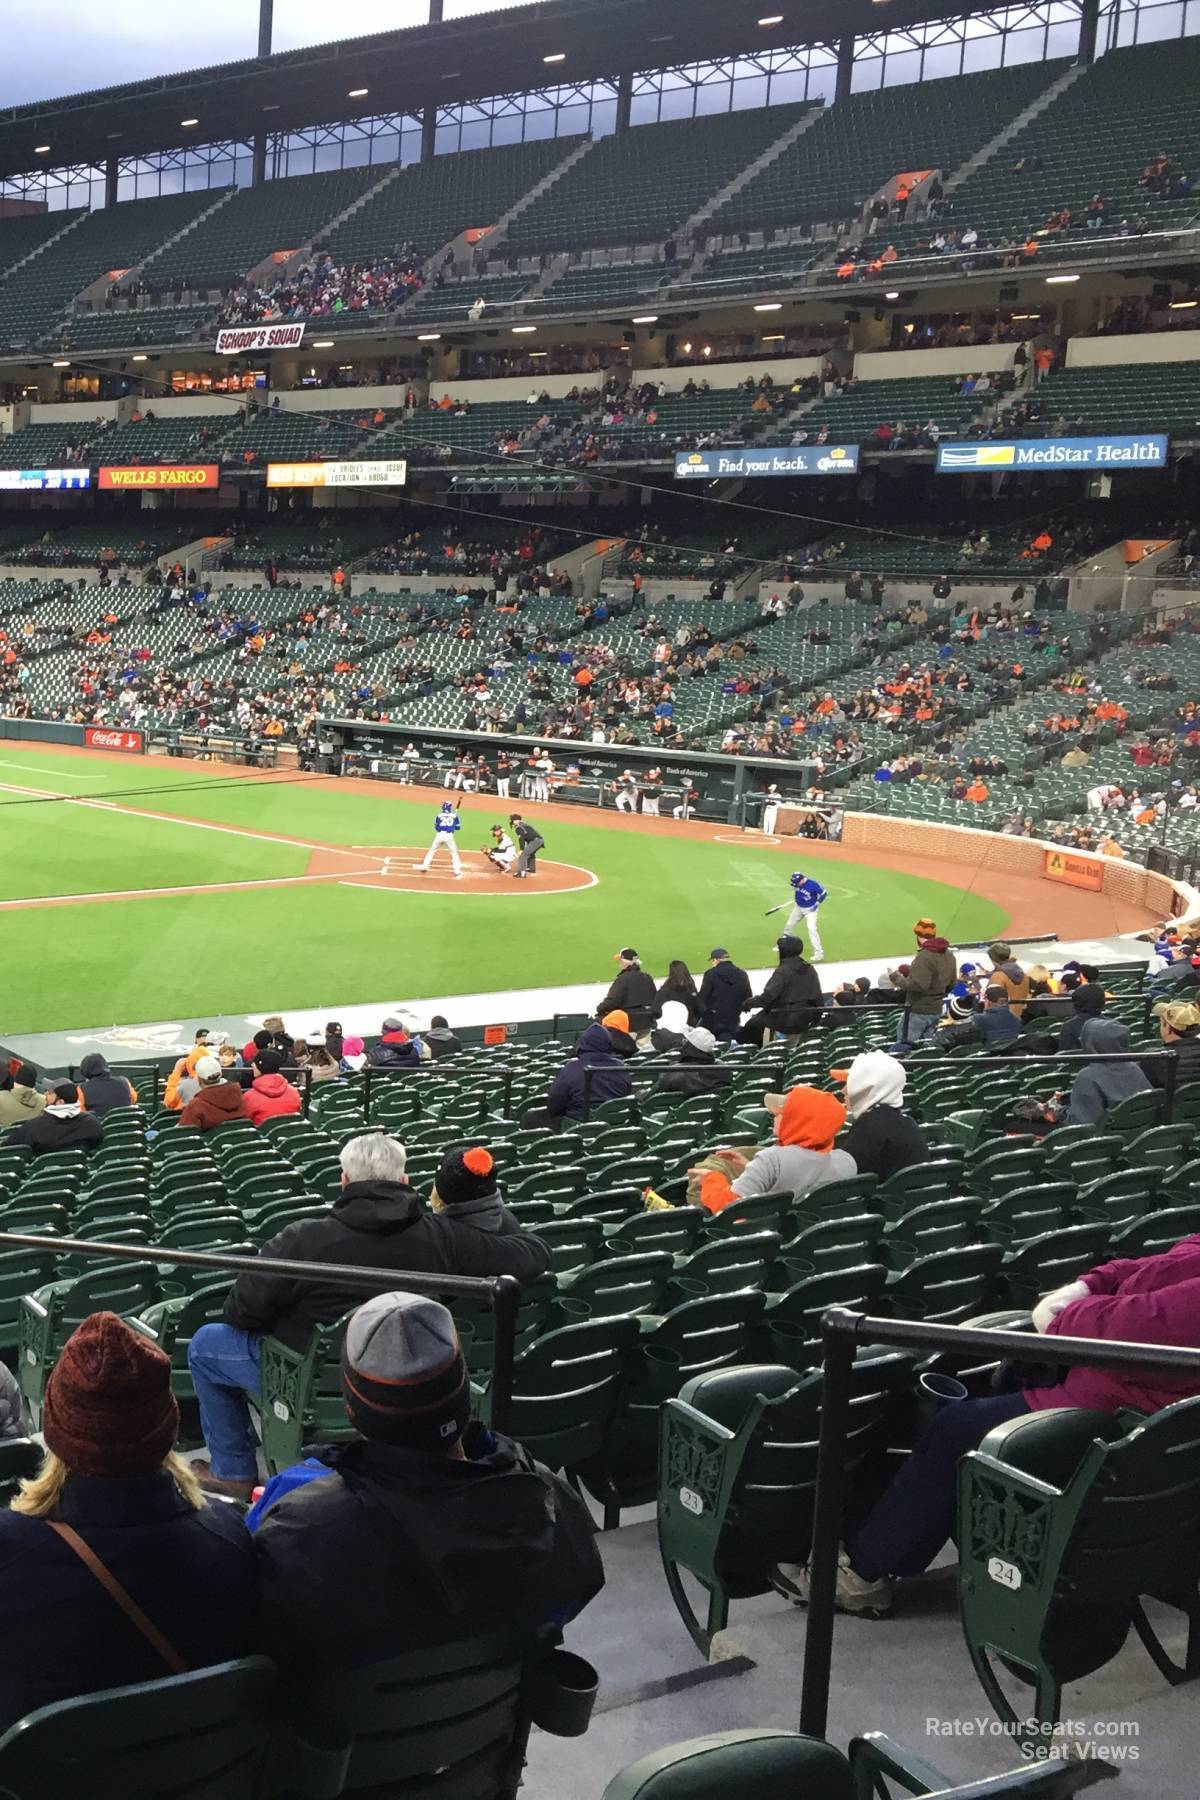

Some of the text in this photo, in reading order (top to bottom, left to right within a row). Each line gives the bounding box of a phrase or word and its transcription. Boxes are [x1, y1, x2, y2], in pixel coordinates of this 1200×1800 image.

[218, 327, 302, 350] SCHOOP'S SQUAD
[1017, 442, 1161, 464] MedStar Health
[718, 458, 743, 473] Find
[745, 460, 770, 476] your
[110, 470, 207, 485] WELLS FARGO
[439, 816, 454, 827] 20
[683, 1490, 699, 1510] 23
[993, 1561, 1014, 1584] 24
